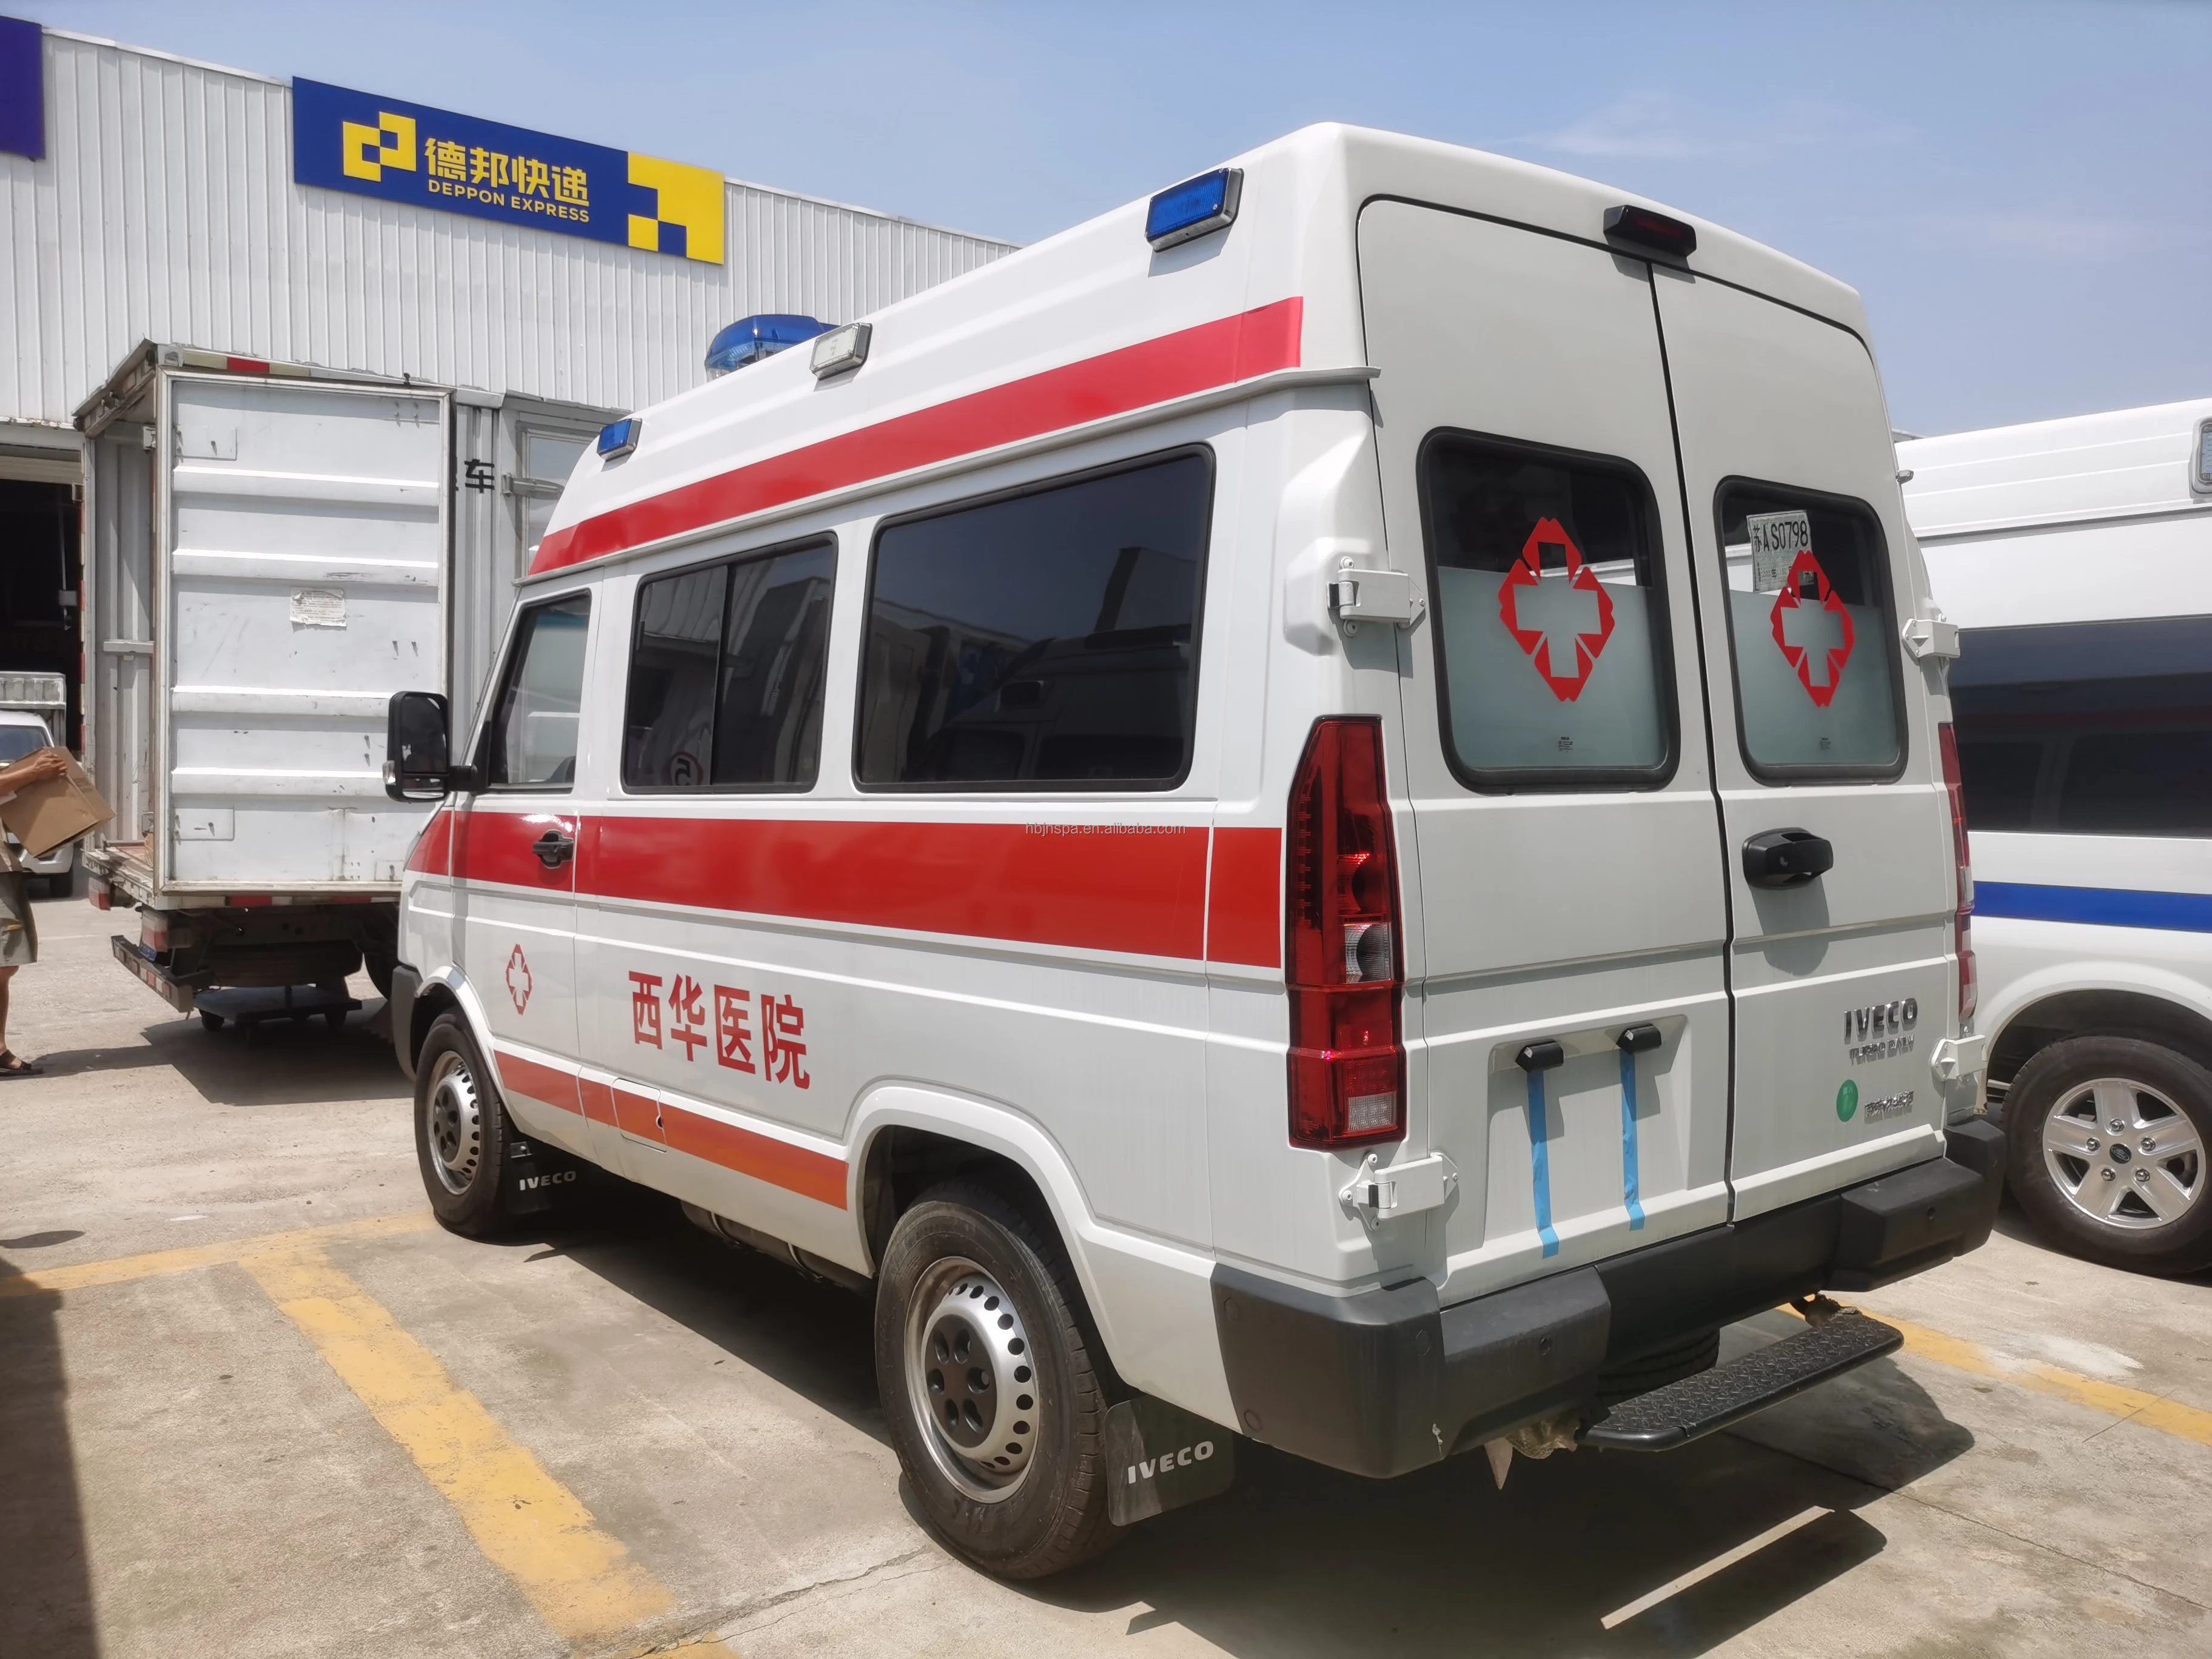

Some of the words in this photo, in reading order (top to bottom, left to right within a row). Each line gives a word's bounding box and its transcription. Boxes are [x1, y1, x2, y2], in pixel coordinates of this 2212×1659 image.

[424, 138, 589, 207] 德邦快递
[428, 179, 504, 206] DEPPON
[511, 196, 589, 223] EXPRESS
[629, 971, 809, 1089] 西华医院
[1844, 998, 1918, 1040] IVECO
[519, 1171, 577, 1191] IVECO
[1128, 1441, 1214, 1484] IVECO
